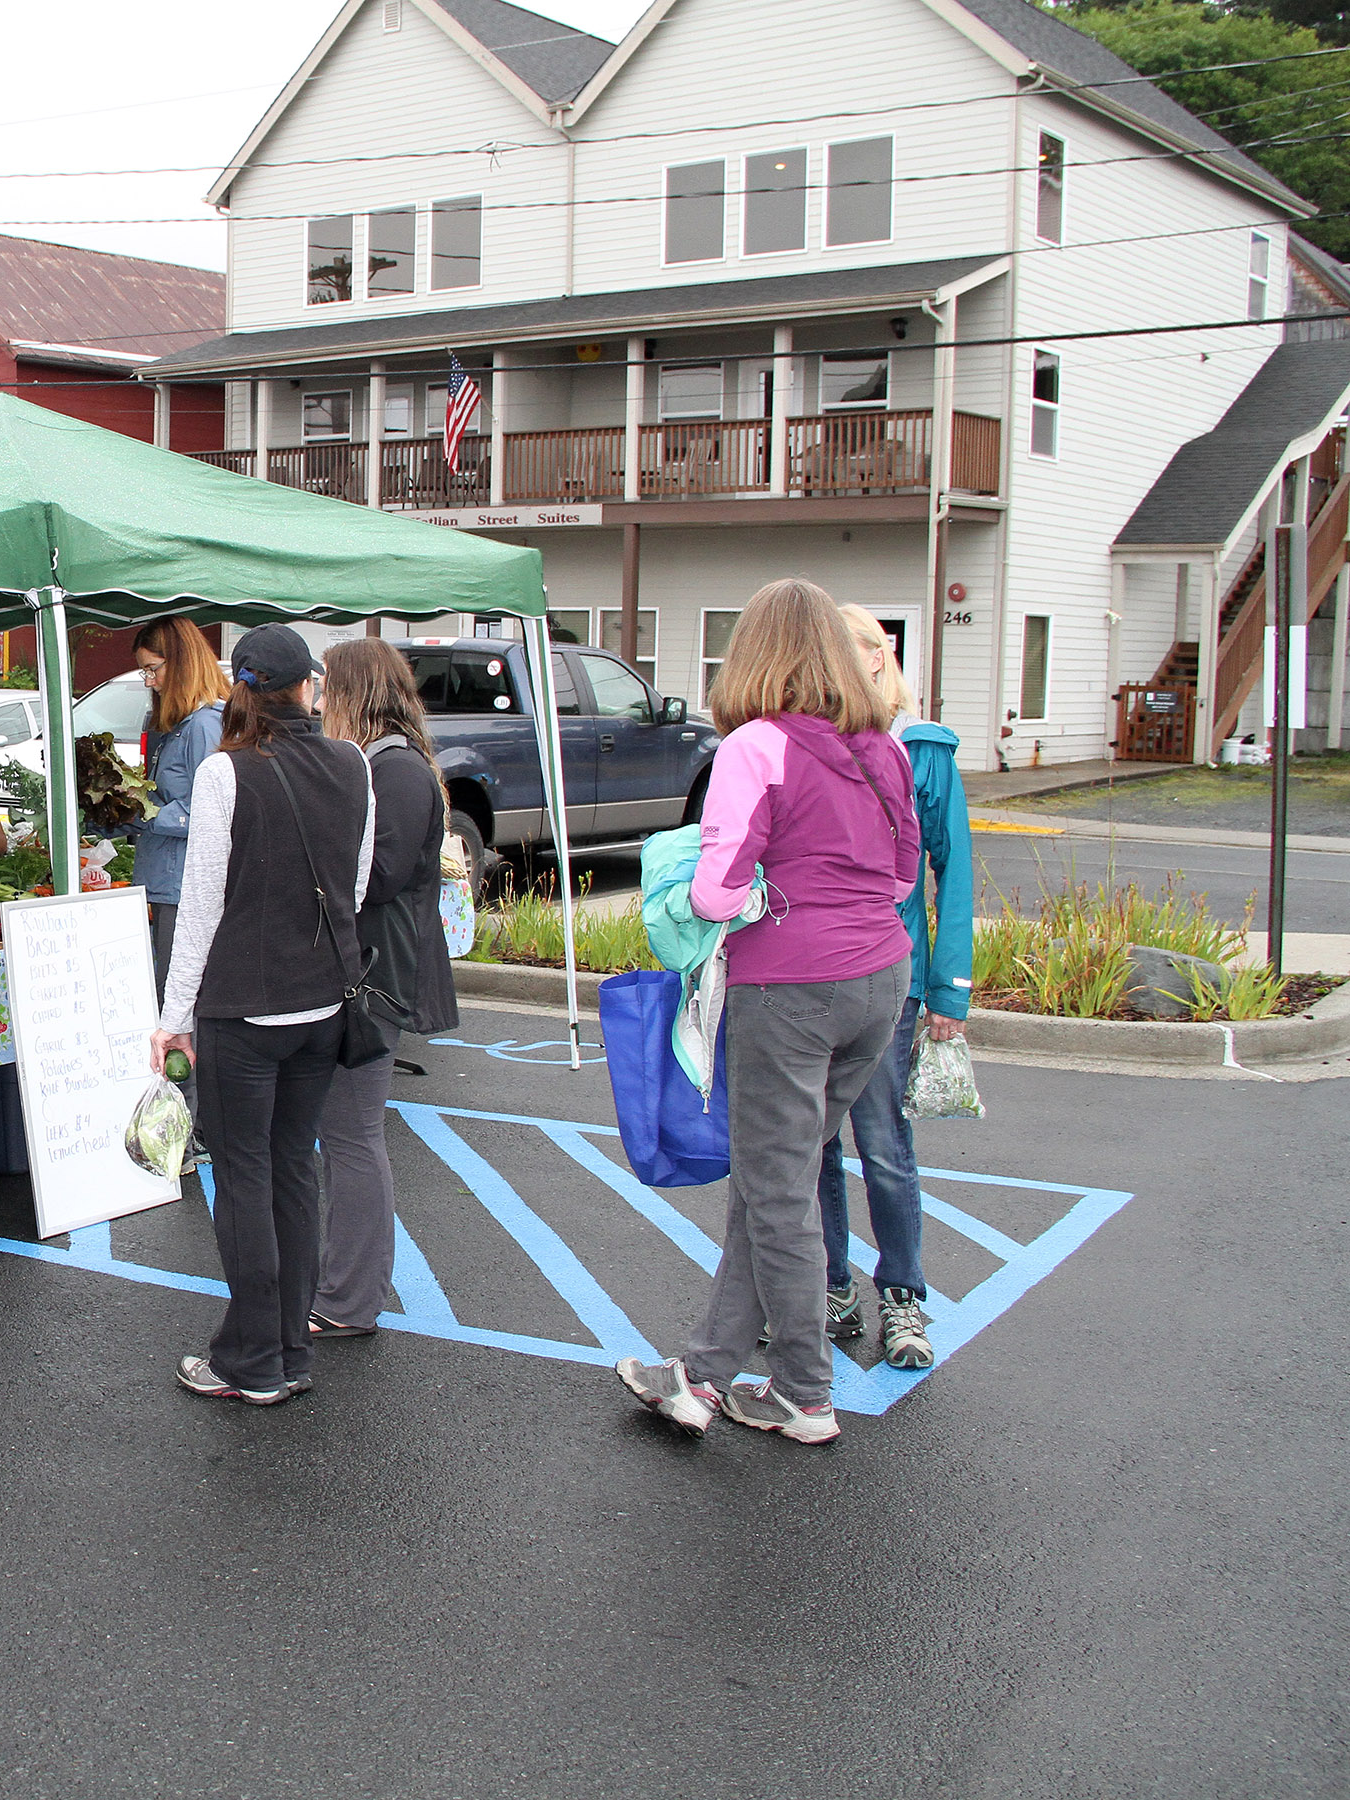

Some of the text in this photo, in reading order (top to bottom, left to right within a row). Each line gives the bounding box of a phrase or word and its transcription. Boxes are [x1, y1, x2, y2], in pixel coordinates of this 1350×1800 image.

[411, 512, 580, 526] tlian Street Suites
[944, 611, 972, 624] 246
